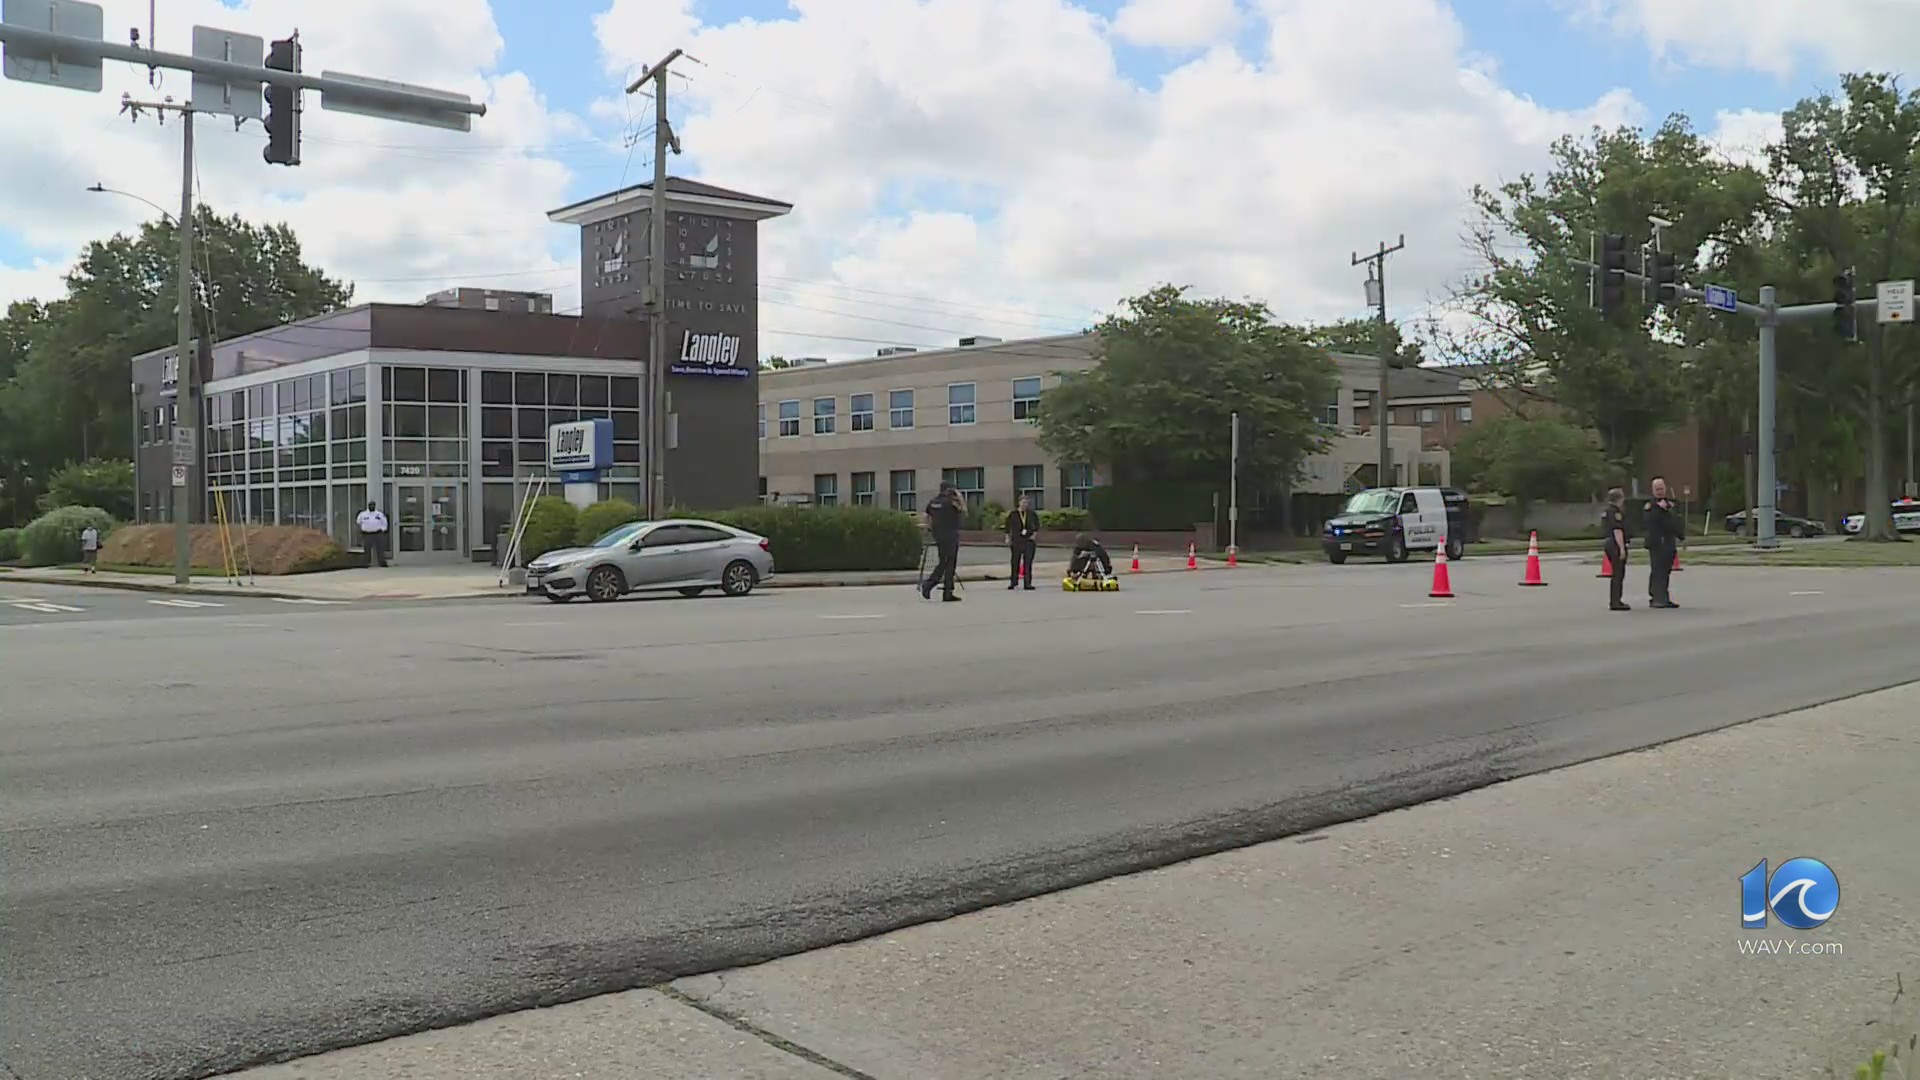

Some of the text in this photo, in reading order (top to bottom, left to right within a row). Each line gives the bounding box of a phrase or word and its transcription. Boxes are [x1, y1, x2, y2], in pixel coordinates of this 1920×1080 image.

[699, 301, 713, 311] TO
[719, 303, 745, 313] SAVE
[681, 328, 740, 366] Langley
[557, 427, 585, 454] Langley
